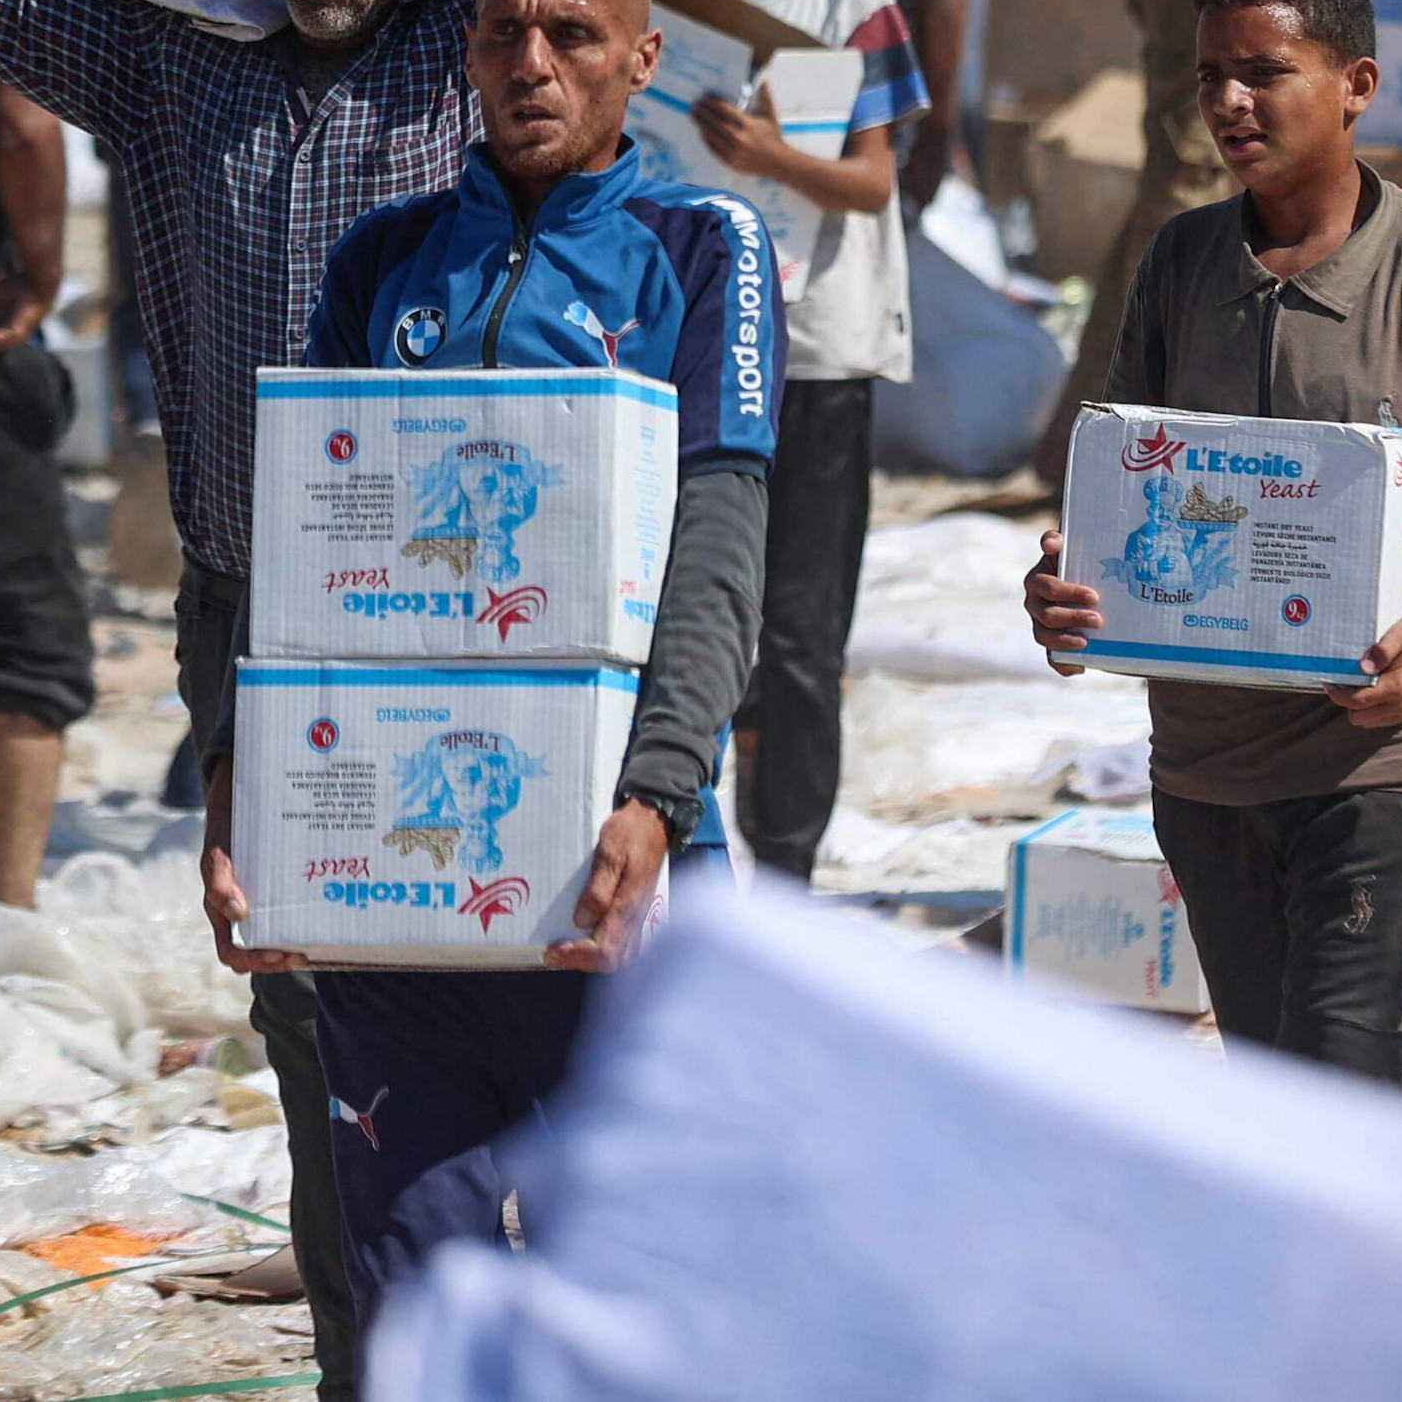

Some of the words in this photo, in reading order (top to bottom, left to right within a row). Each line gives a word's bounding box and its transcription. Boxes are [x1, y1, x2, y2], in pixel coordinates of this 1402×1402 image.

[402, 309, 445, 331] BMW
[733, 220, 764, 418] Motorsport
[456, 439, 515, 462] L'Etoile
[1186, 447, 1303, 478] L'Etoile
[1259, 478, 1321, 500] Yeast
[322, 567, 389, 594] Yeast
[342, 591, 474, 620] L'Etoile
[1141, 583, 1193, 604] L'Etoile
[439, 732, 499, 753] L'Etoile
[302, 857, 370, 881] Yeast
[323, 882, 455, 910] L'Etoile
